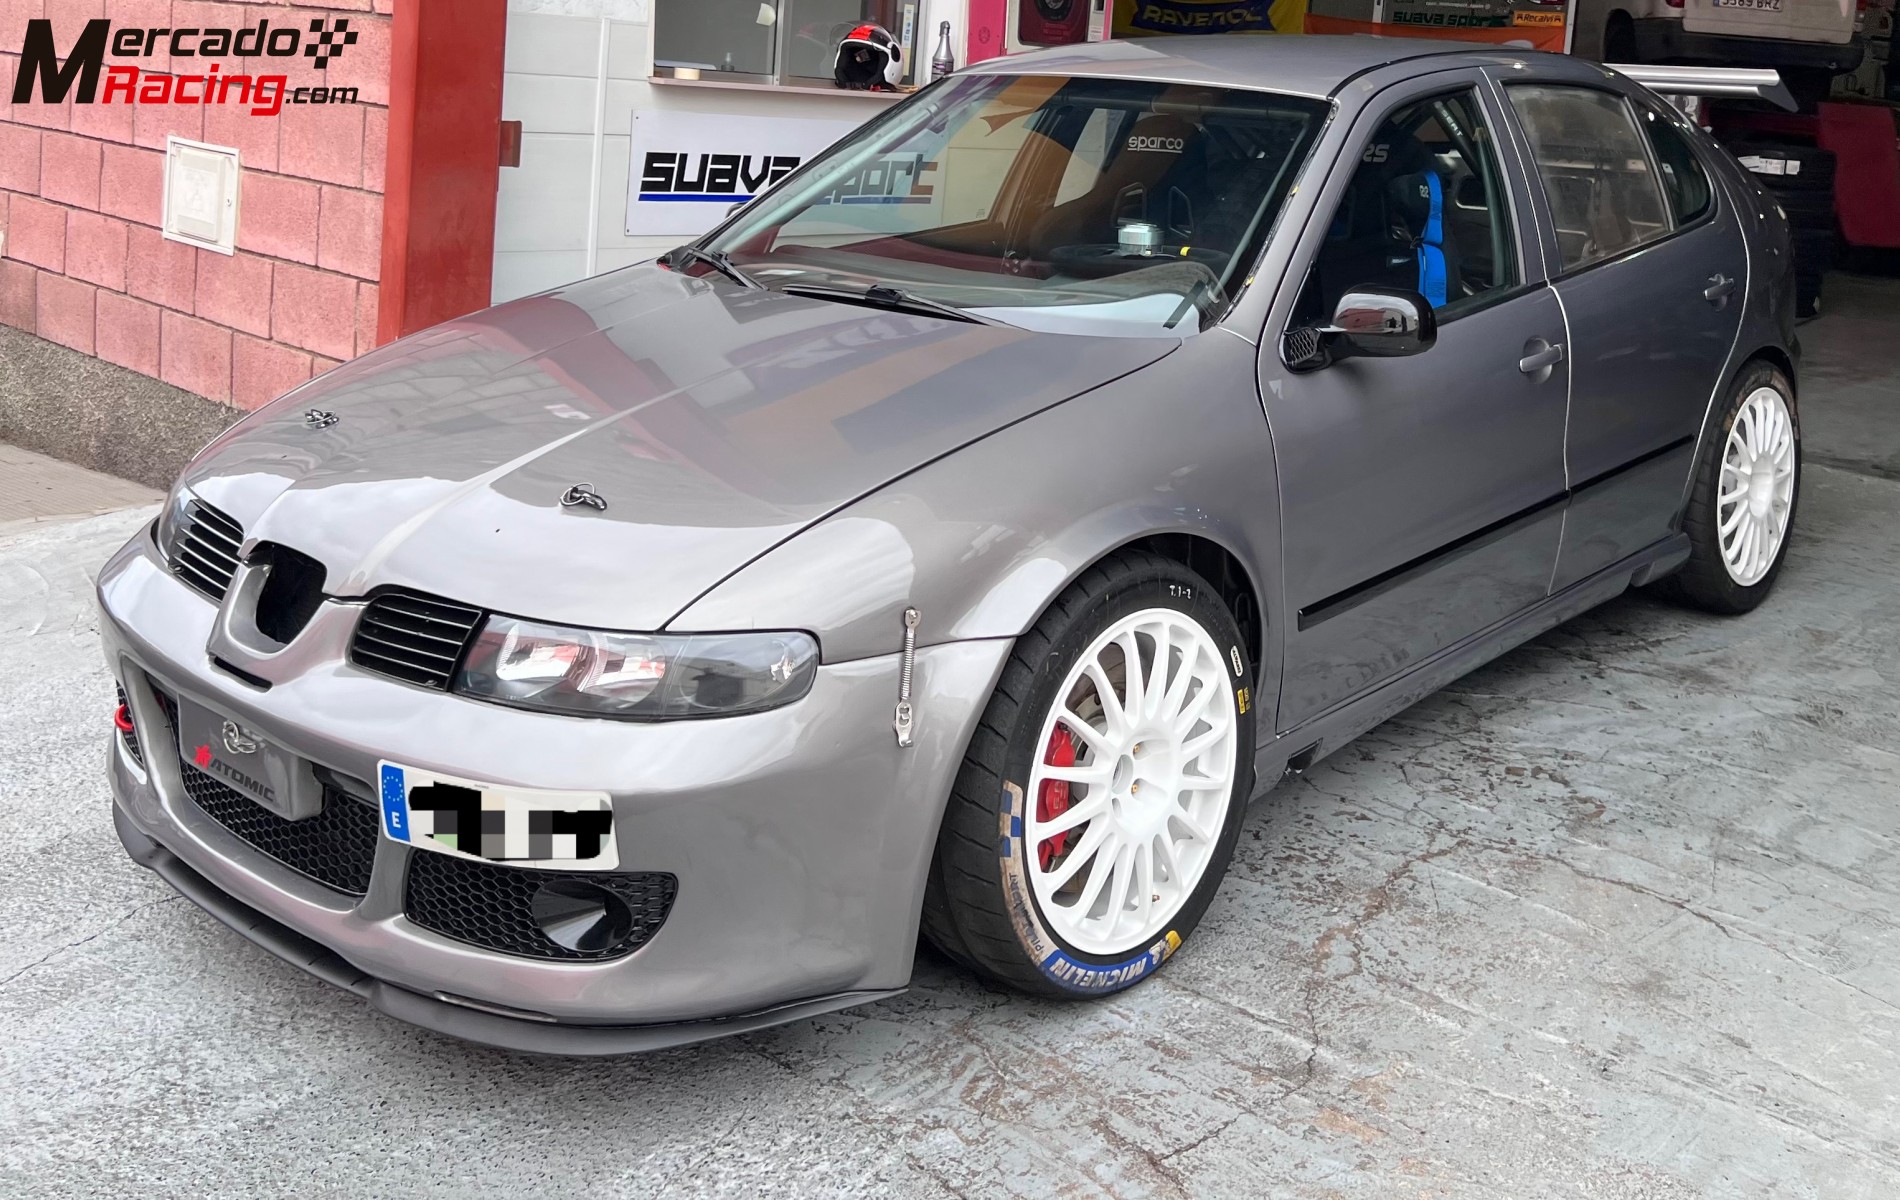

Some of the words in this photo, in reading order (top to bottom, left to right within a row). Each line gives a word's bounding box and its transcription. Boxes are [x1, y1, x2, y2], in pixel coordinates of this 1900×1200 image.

[1128, 136, 1184, 151] sparco
[210, 758, 275, 803] ATOMIC
[392, 812, 401, 828] E
[1050, 956, 1148, 989] MICHELIN
